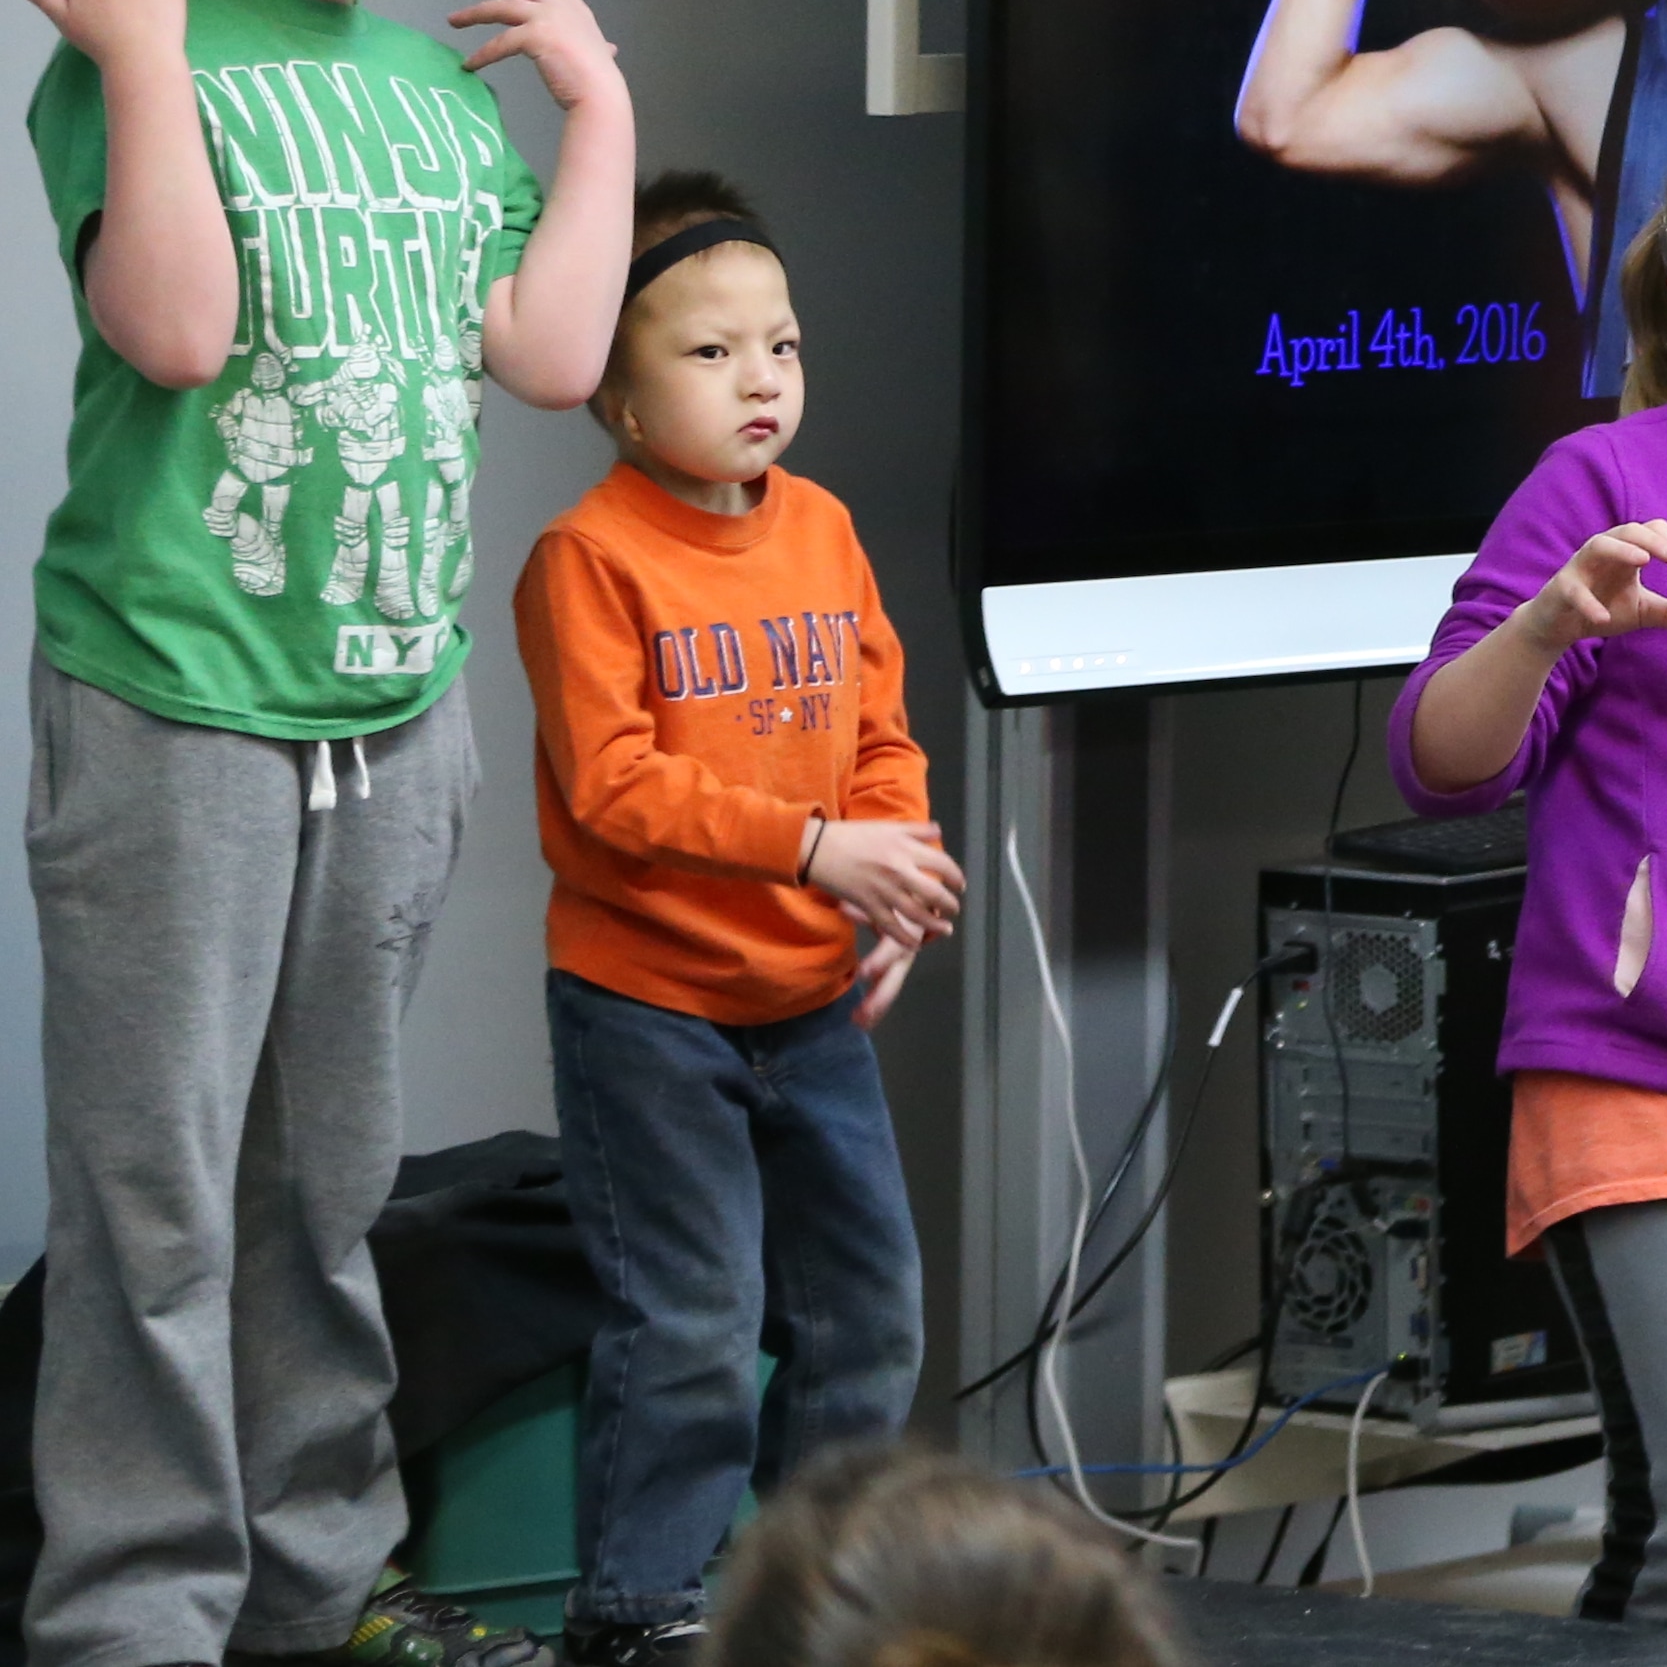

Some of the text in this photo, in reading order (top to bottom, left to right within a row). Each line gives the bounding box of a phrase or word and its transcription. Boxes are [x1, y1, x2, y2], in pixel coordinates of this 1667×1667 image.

[1256, 301, 1547, 387] April 4th, 2016
[653, 621, 749, 701] OLD
[749, 693, 832, 736] SF NY
